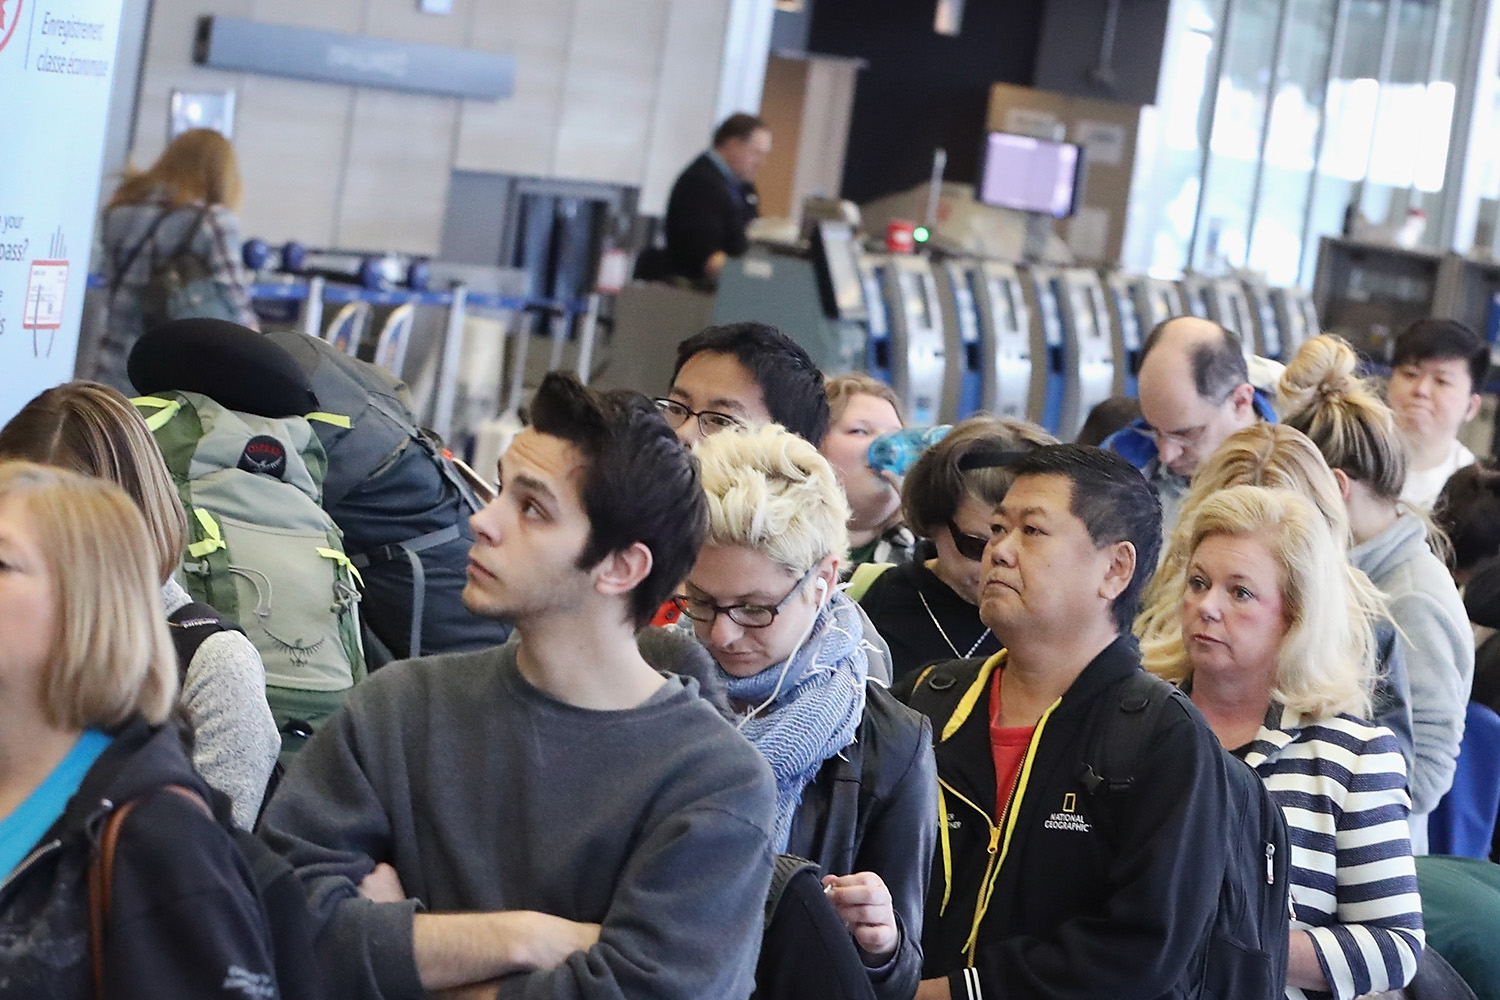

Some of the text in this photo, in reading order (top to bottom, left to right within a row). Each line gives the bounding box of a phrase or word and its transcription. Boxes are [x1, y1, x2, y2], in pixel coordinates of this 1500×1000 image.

[36, 48, 67, 74] classe
[2, 215, 24, 234] your
[1044, 820, 1090, 832] GEOGRAPHIC
[1050, 813, 1084, 824] NATIONAL
